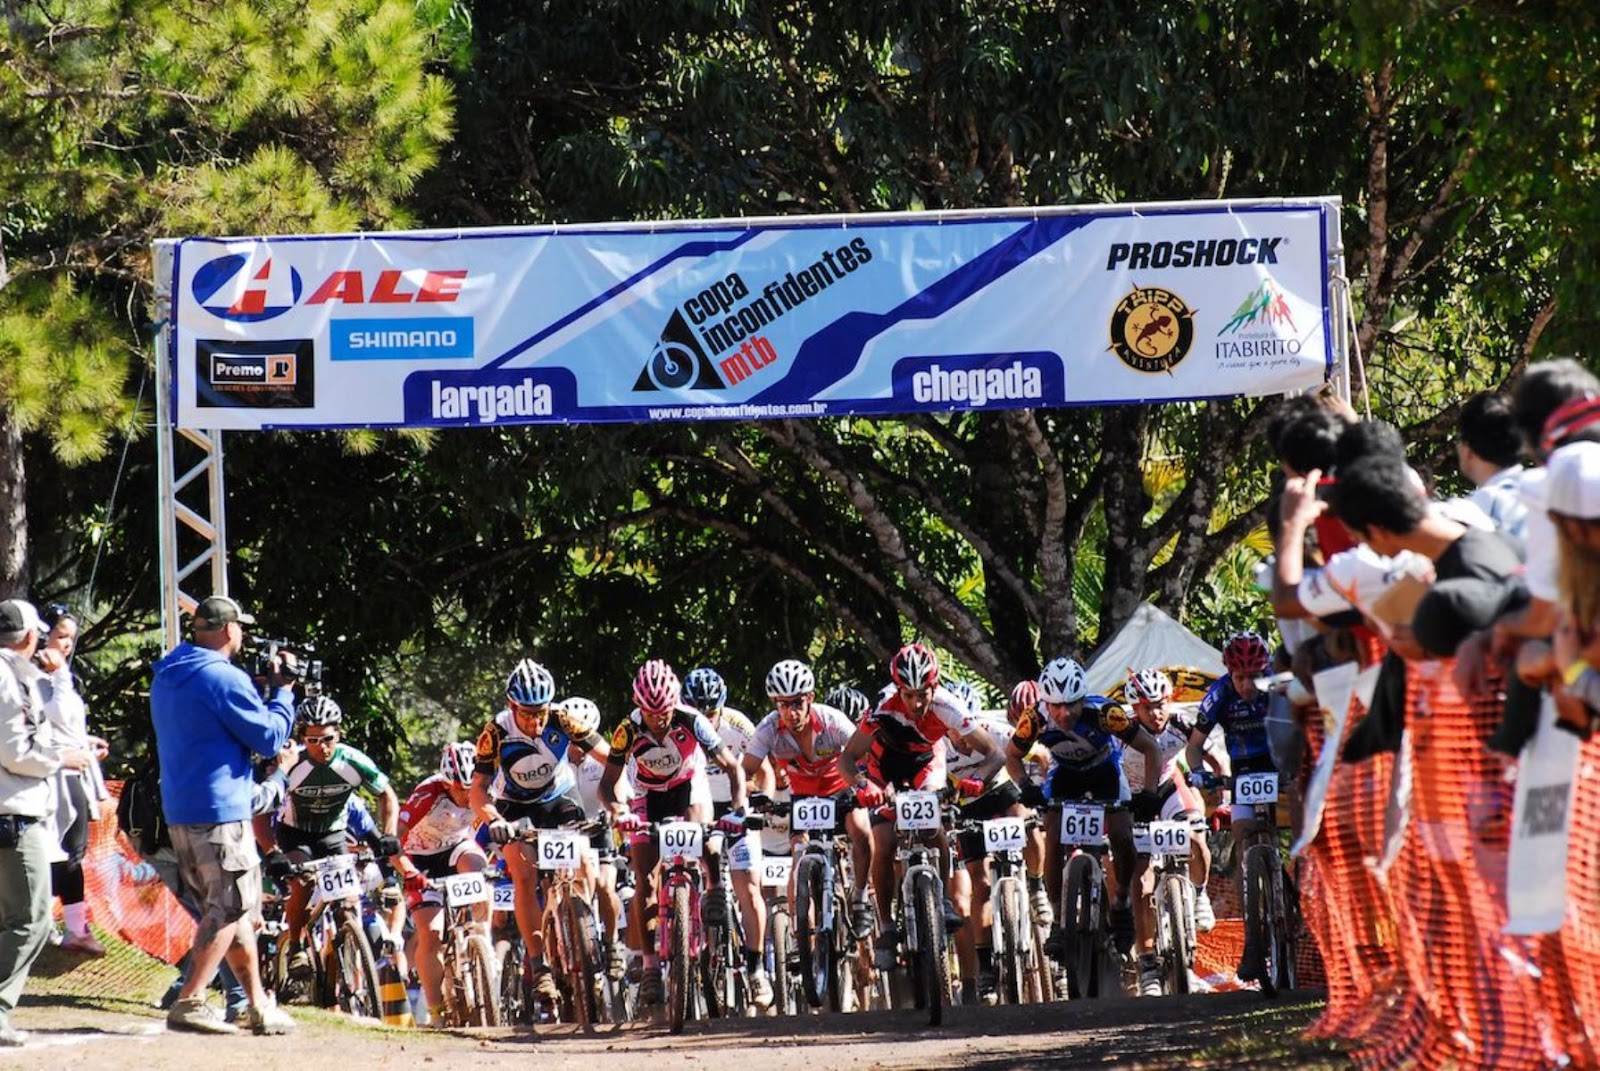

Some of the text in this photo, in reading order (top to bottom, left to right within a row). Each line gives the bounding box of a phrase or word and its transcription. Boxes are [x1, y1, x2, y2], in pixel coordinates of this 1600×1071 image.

[1107, 238, 1282, 270] PROSHOCK
[304, 270, 468, 305] ALE
[698, 237, 872, 356] inconfidentes
[684, 272, 749, 325] copa
[349, 330, 456, 349] SHIMANO
[1216, 339, 1301, 359] ITABIRITO
[216, 362, 264, 376] Premo
[720, 335, 777, 386] mtb
[912, 361, 1042, 406] chegada
[432, 378, 552, 423] largada
[1241, 780, 1274, 796] 606
[798, 805, 830, 820] 610
[901, 801, 934, 820] 623
[988, 825, 1020, 842] 612
[1066, 816, 1099, 836] 615
[665, 829, 697, 847] 607
[1154, 829, 1185, 846] 616
[544, 841, 574, 859] 621
[323, 869, 353, 891] 614
[452, 880, 482, 897] 620
